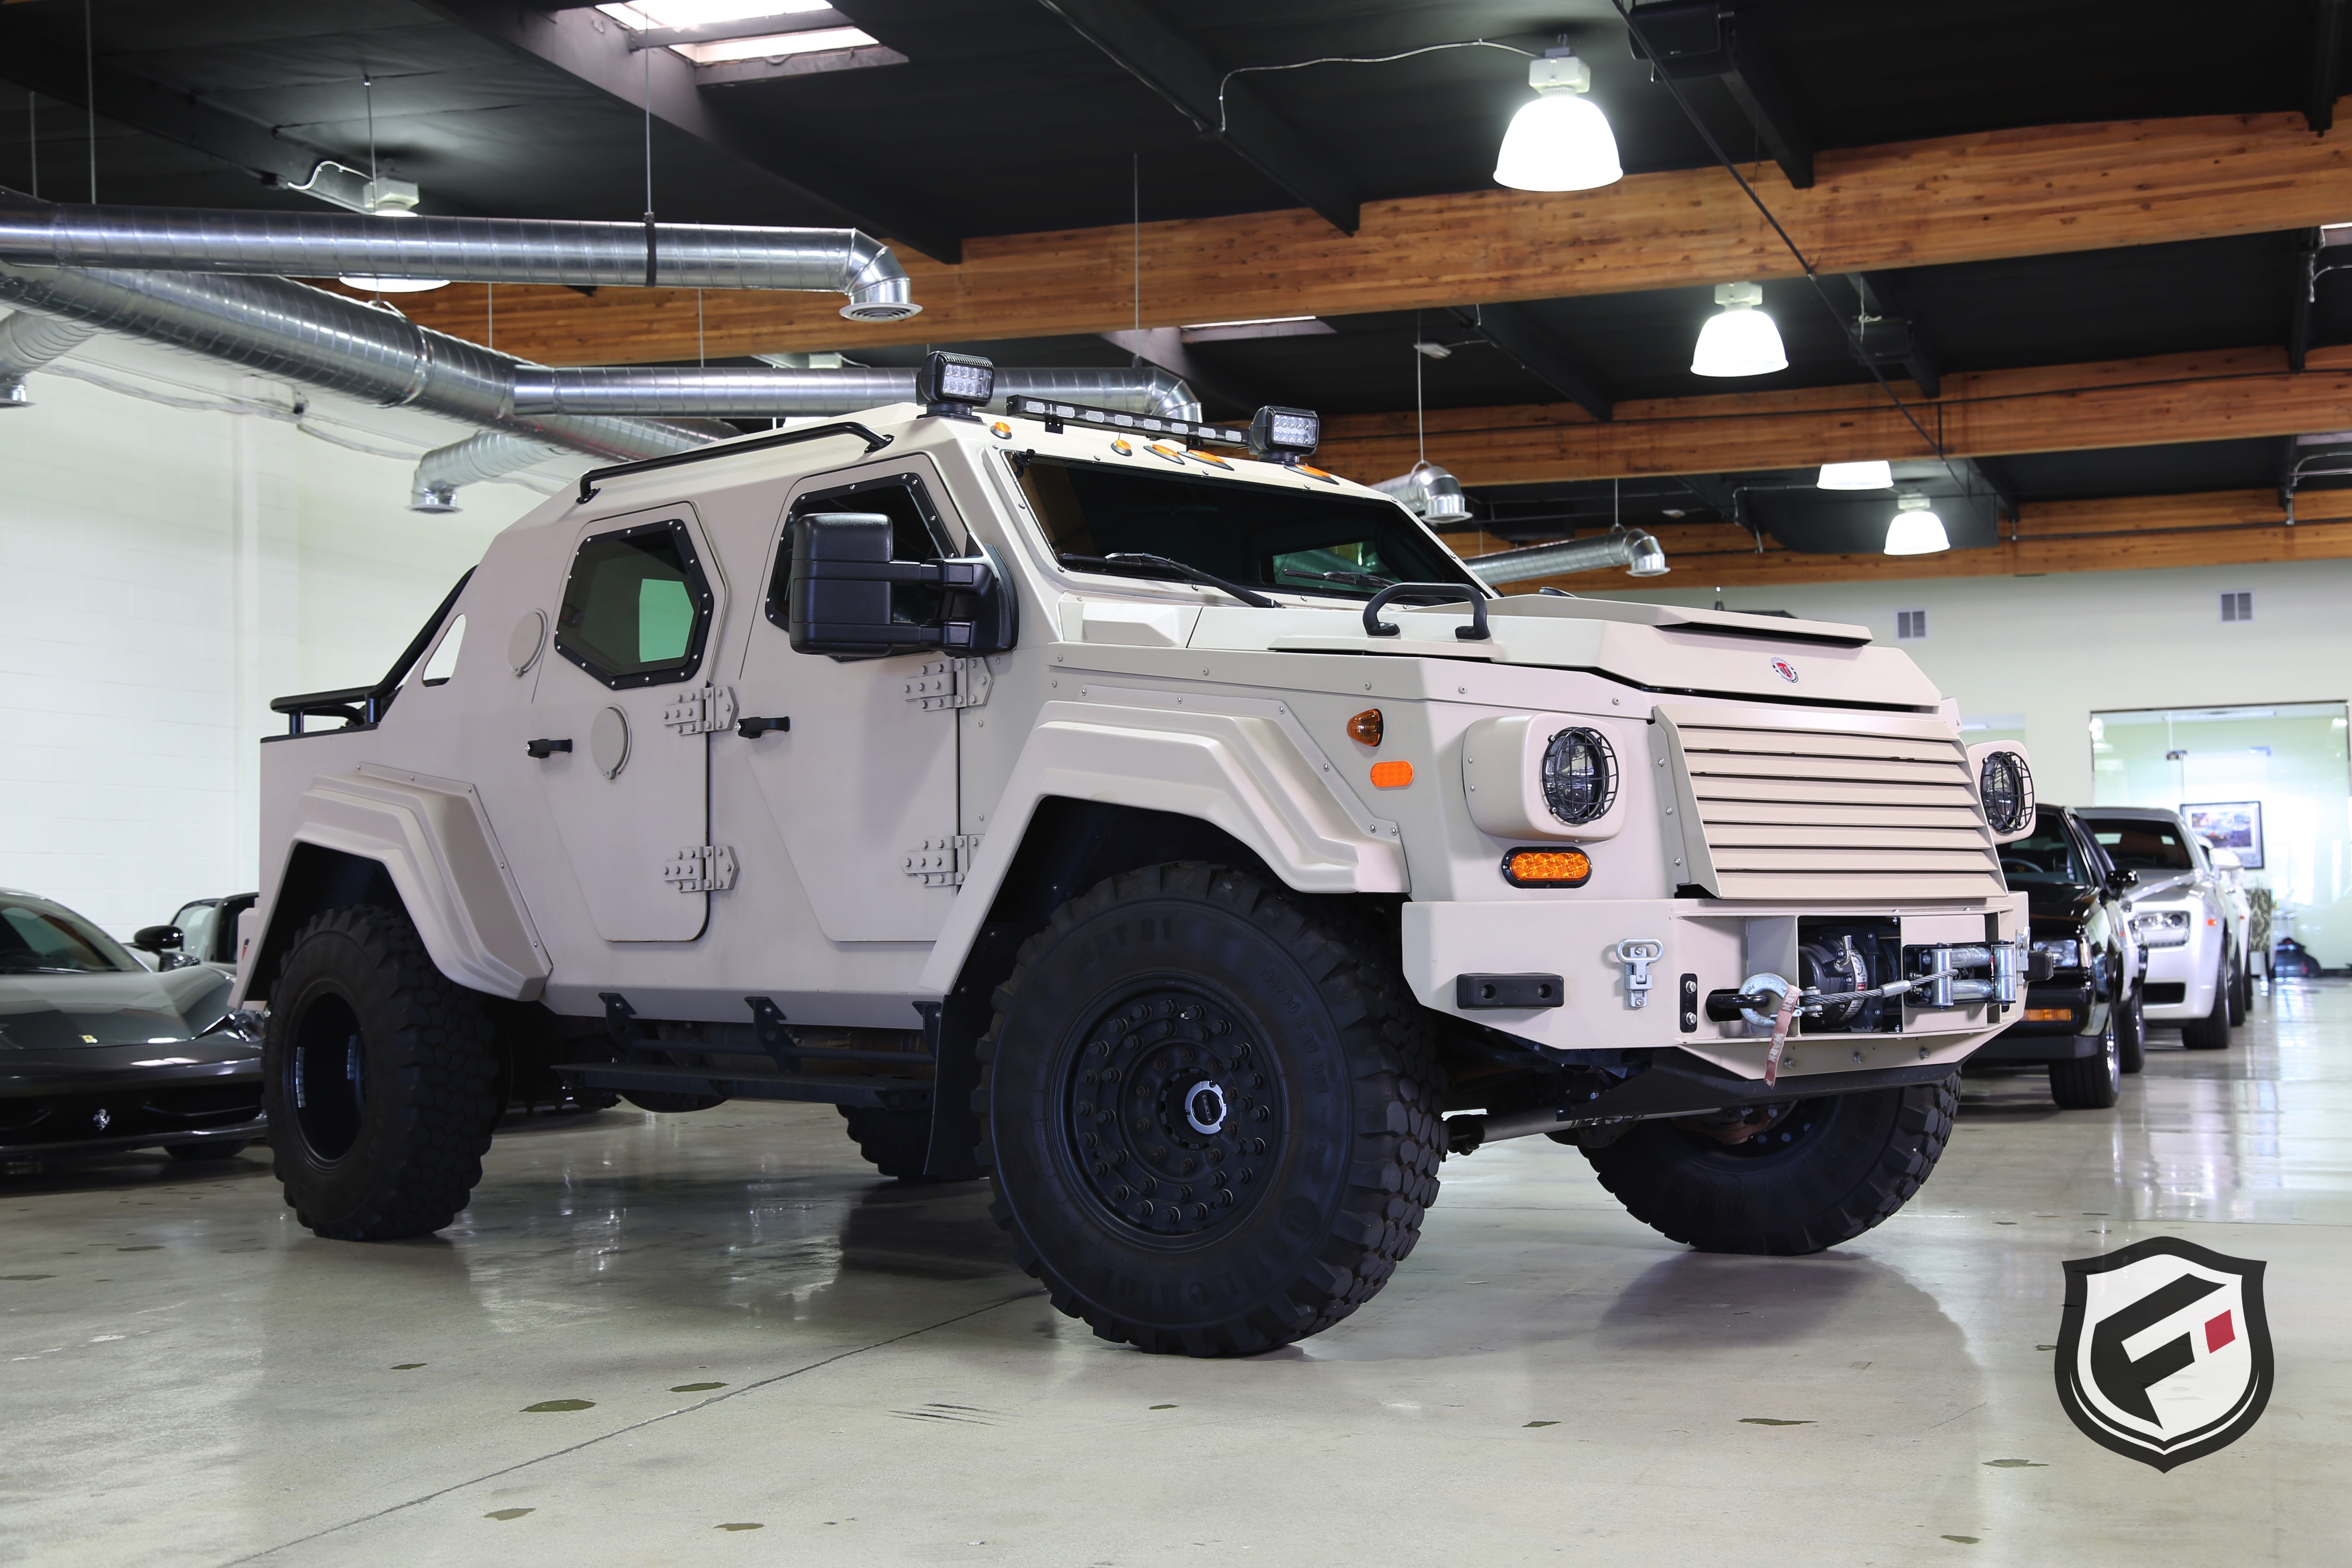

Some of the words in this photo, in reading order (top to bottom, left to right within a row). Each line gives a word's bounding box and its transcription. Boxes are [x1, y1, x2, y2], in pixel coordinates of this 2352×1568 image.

[1070, 922, 1128, 971] MPT
[1140, 918, 1172, 942] 81
[1257, 964, 1299, 1013] 335/80
[1296, 1016, 1307, 1029] R
[1312, 1059, 1328, 1093] MPT
[1202, 1095, 1211, 1120] FORD
